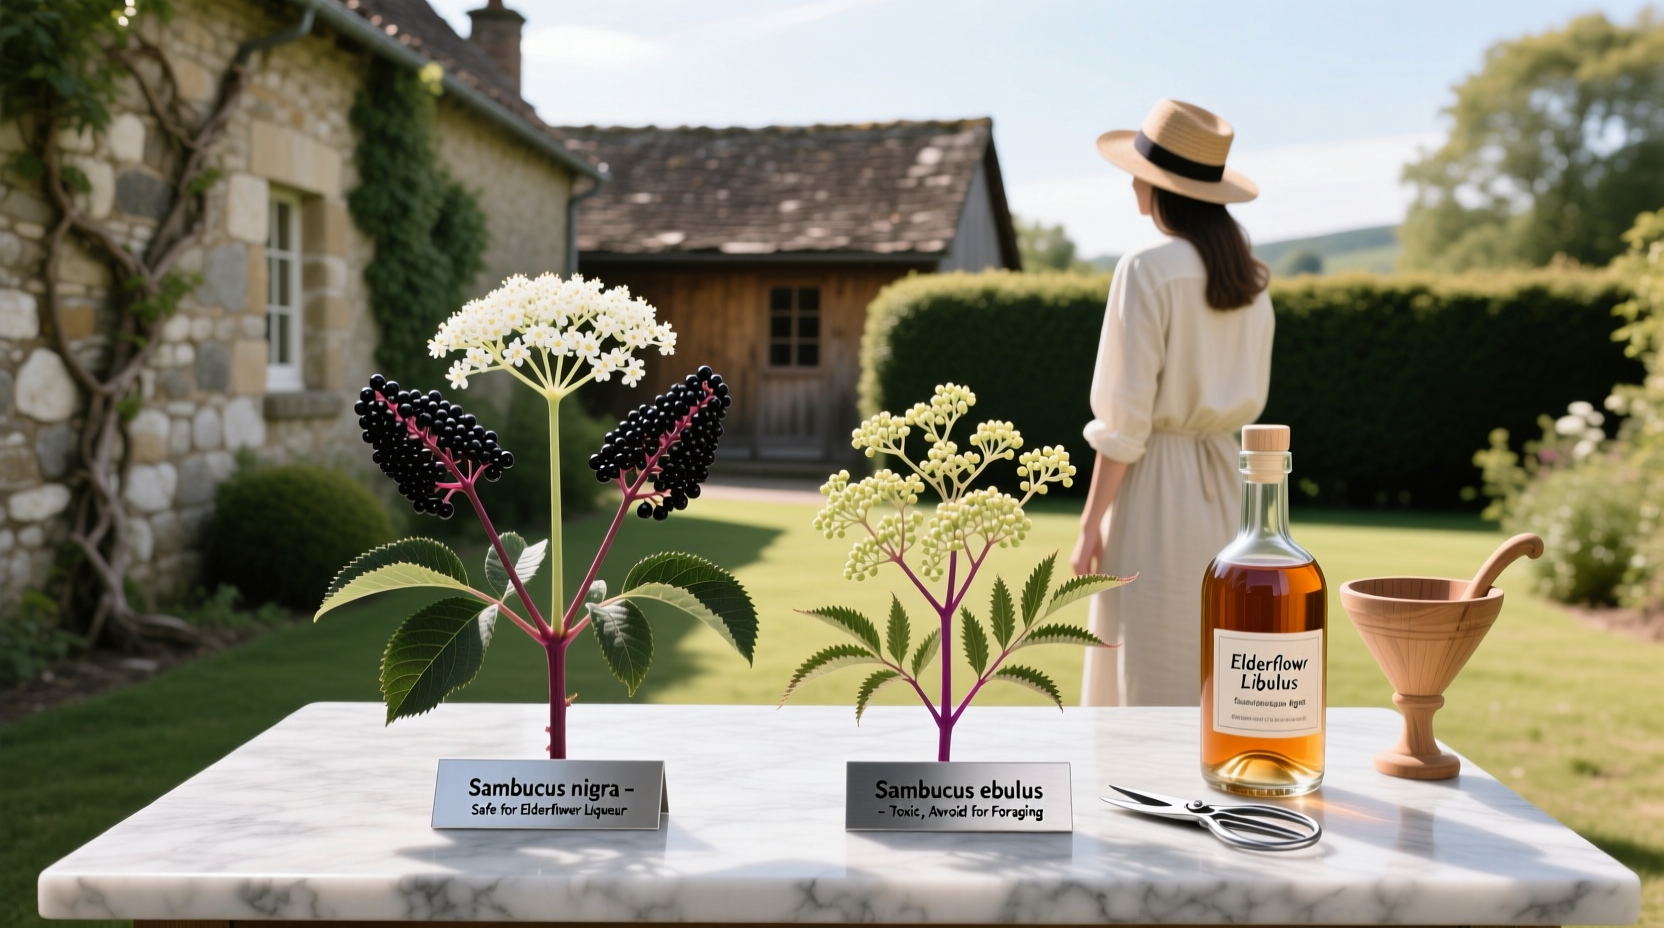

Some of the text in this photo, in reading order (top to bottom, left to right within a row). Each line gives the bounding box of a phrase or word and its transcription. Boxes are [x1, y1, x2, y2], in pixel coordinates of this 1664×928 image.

[1241, 673, 1298, 691] Libulus
[468, 777, 566, 797] Sambucus
[571, 778, 620, 802] nigra
[875, 779, 1044, 799] Sambucus ebulus
[471, 803, 497, 815] Safe
[500, 803, 517, 815] for
[889, 805, 926, 820] Toxic,
[972, 805, 989, 817] for
[991, 805, 1044, 821] Foraging
